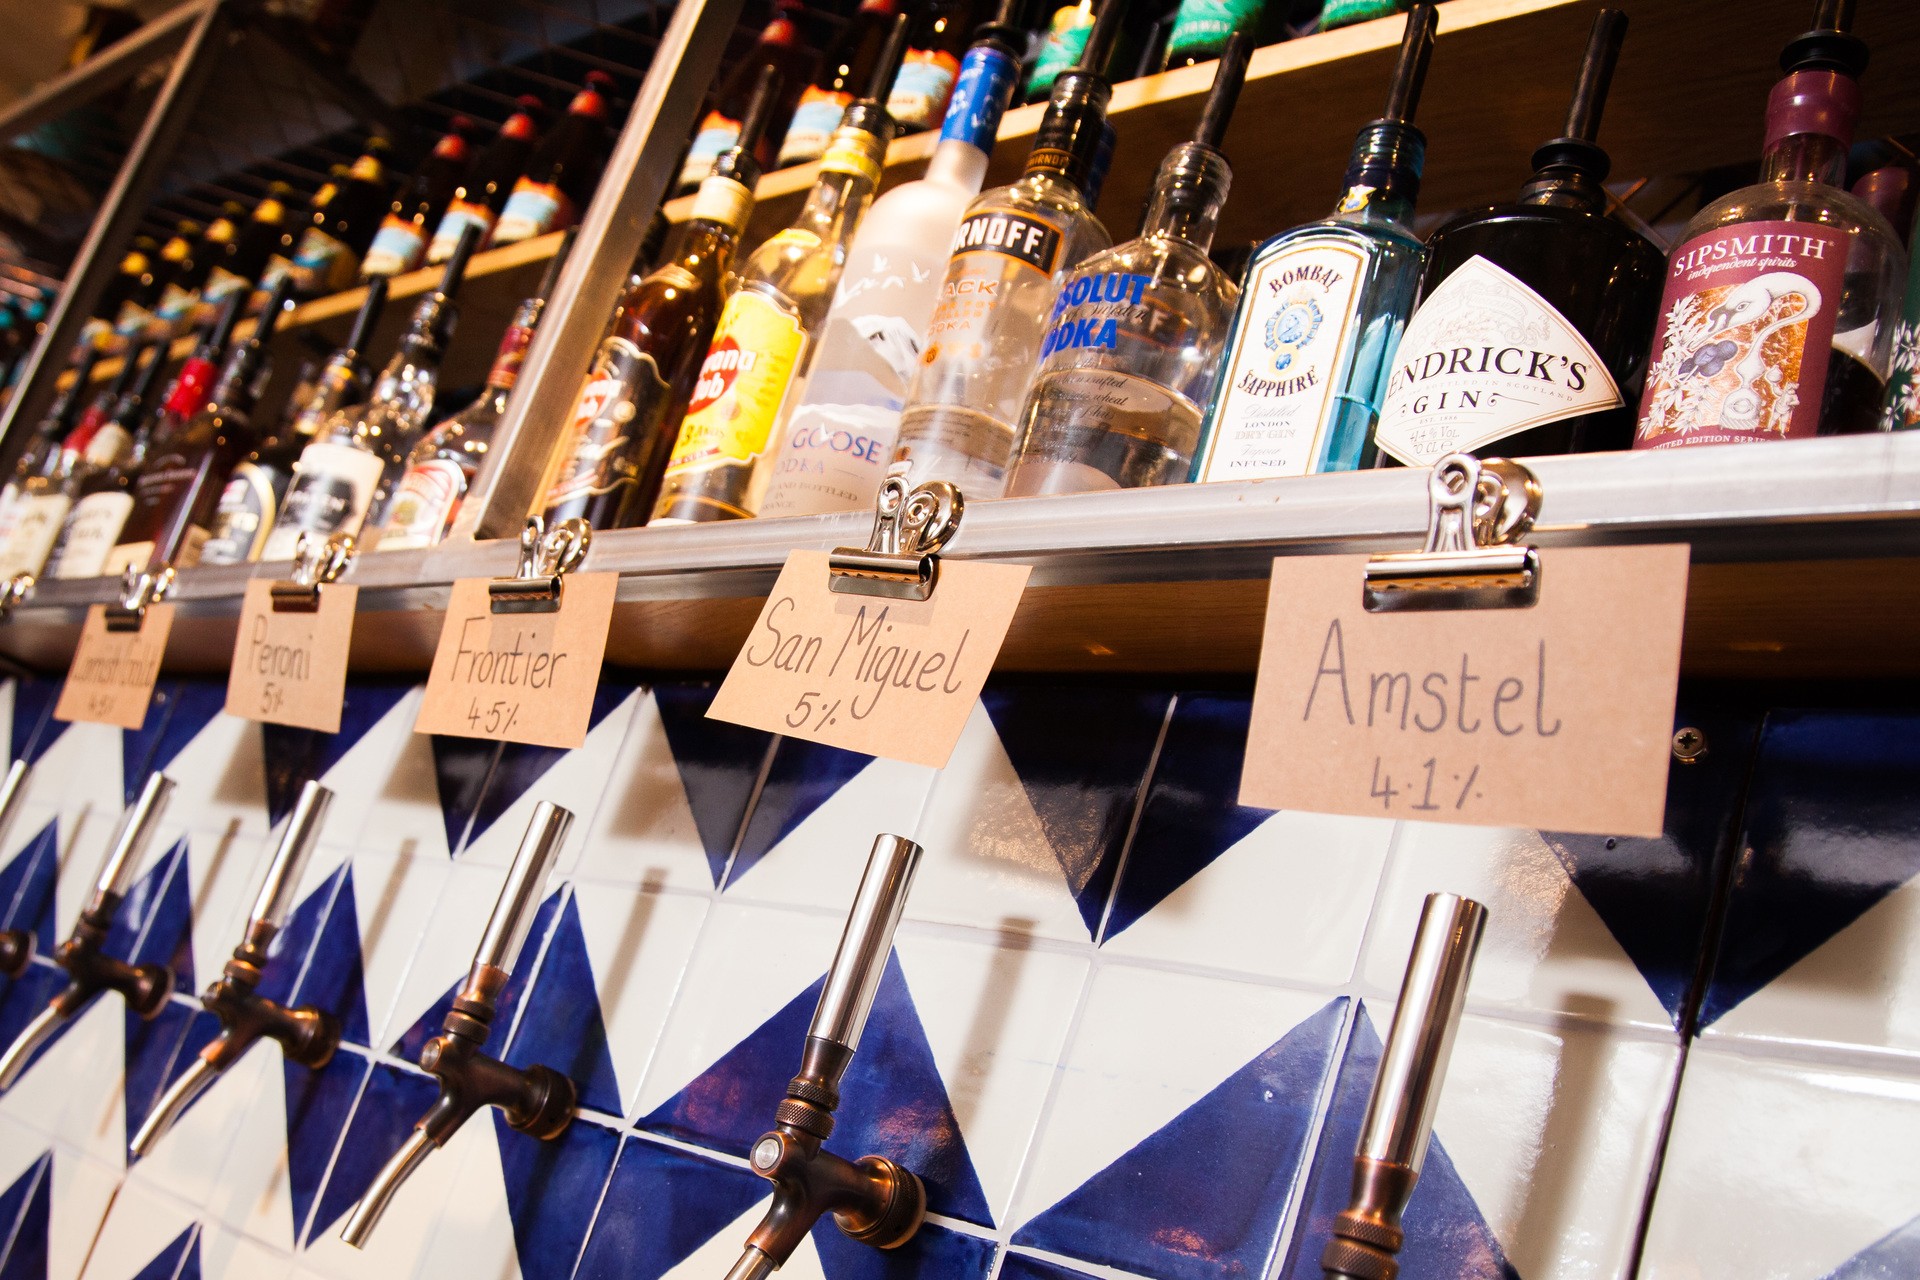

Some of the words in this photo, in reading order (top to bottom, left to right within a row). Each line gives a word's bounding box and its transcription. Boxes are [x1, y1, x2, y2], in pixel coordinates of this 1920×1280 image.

[952, 217, 1044, 255] RNOFF
[1673, 234, 1827, 278] SIPSMITH
[1687, 256, 1758, 282] independent
[1757, 256, 1798, 273] spirits
[1268, 264, 1344, 299] BOMBAY
[1040, 317, 1119, 361] ODKA
[1237, 364, 1320, 398] SAPPHIRE
[1387, 346, 1588, 400] ENDRICK'S
[1413, 390, 1483, 415] GIN
[1506, 381, 1573, 402] SCOTLAND
[1241, 403, 1302, 420] Distilled
[1244, 420, 1291, 429] LONDON
[1235, 430, 1264, 441] DRY
[1267, 428, 1297, 440] GIN
[1685, 434, 1731, 446] EDITION
[1229, 459, 1287, 468] INFUSED
[246, 613, 314, 681] Peroni
[450, 615, 568, 689] Frontier
[746, 596, 823, 674] San
[827, 604, 972, 720] Miguel
[1302, 617, 1562, 738] Amstel
[785, 691, 842, 732] 5%
